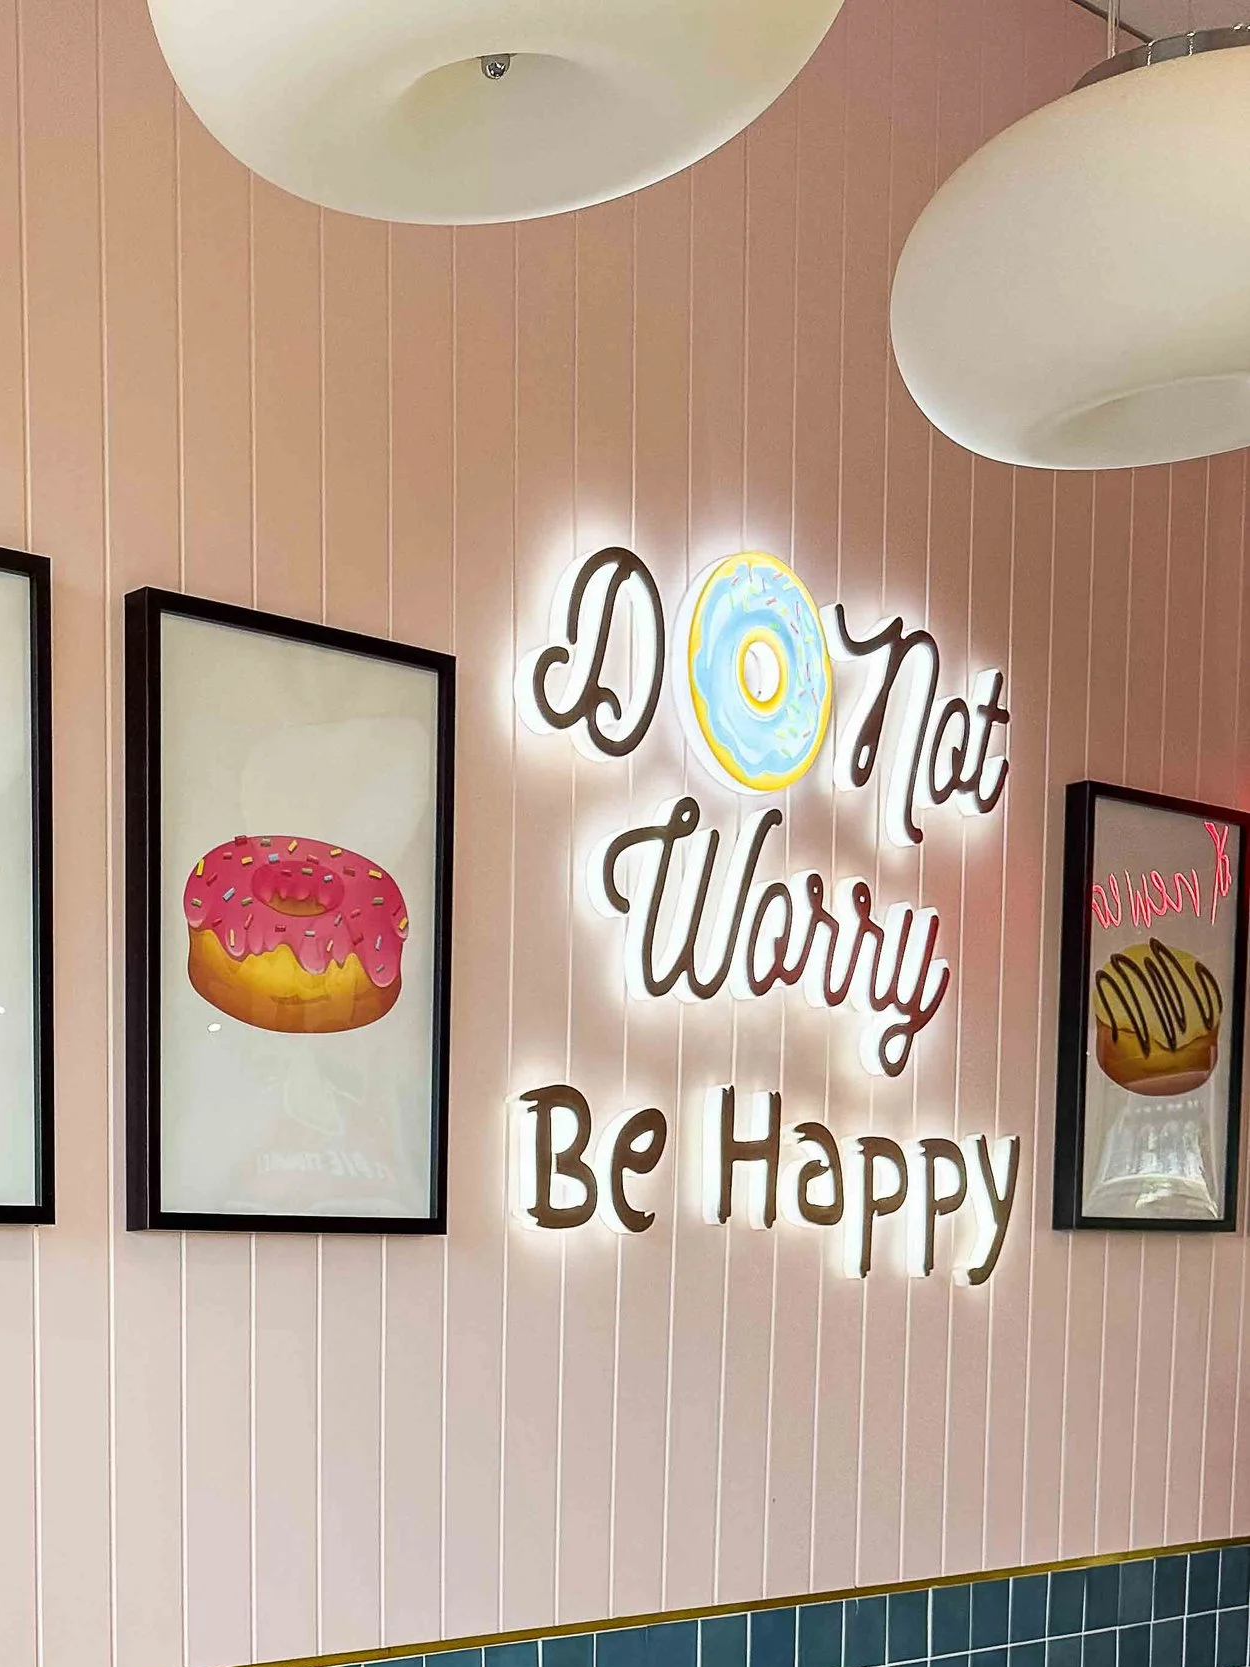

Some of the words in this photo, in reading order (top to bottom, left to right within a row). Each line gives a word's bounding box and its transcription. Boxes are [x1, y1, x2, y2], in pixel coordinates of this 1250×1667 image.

[603, 797, 950, 1077] Worry
[519, 1084, 667, 1232] Be
[719, 1084, 1020, 1285] Happy
